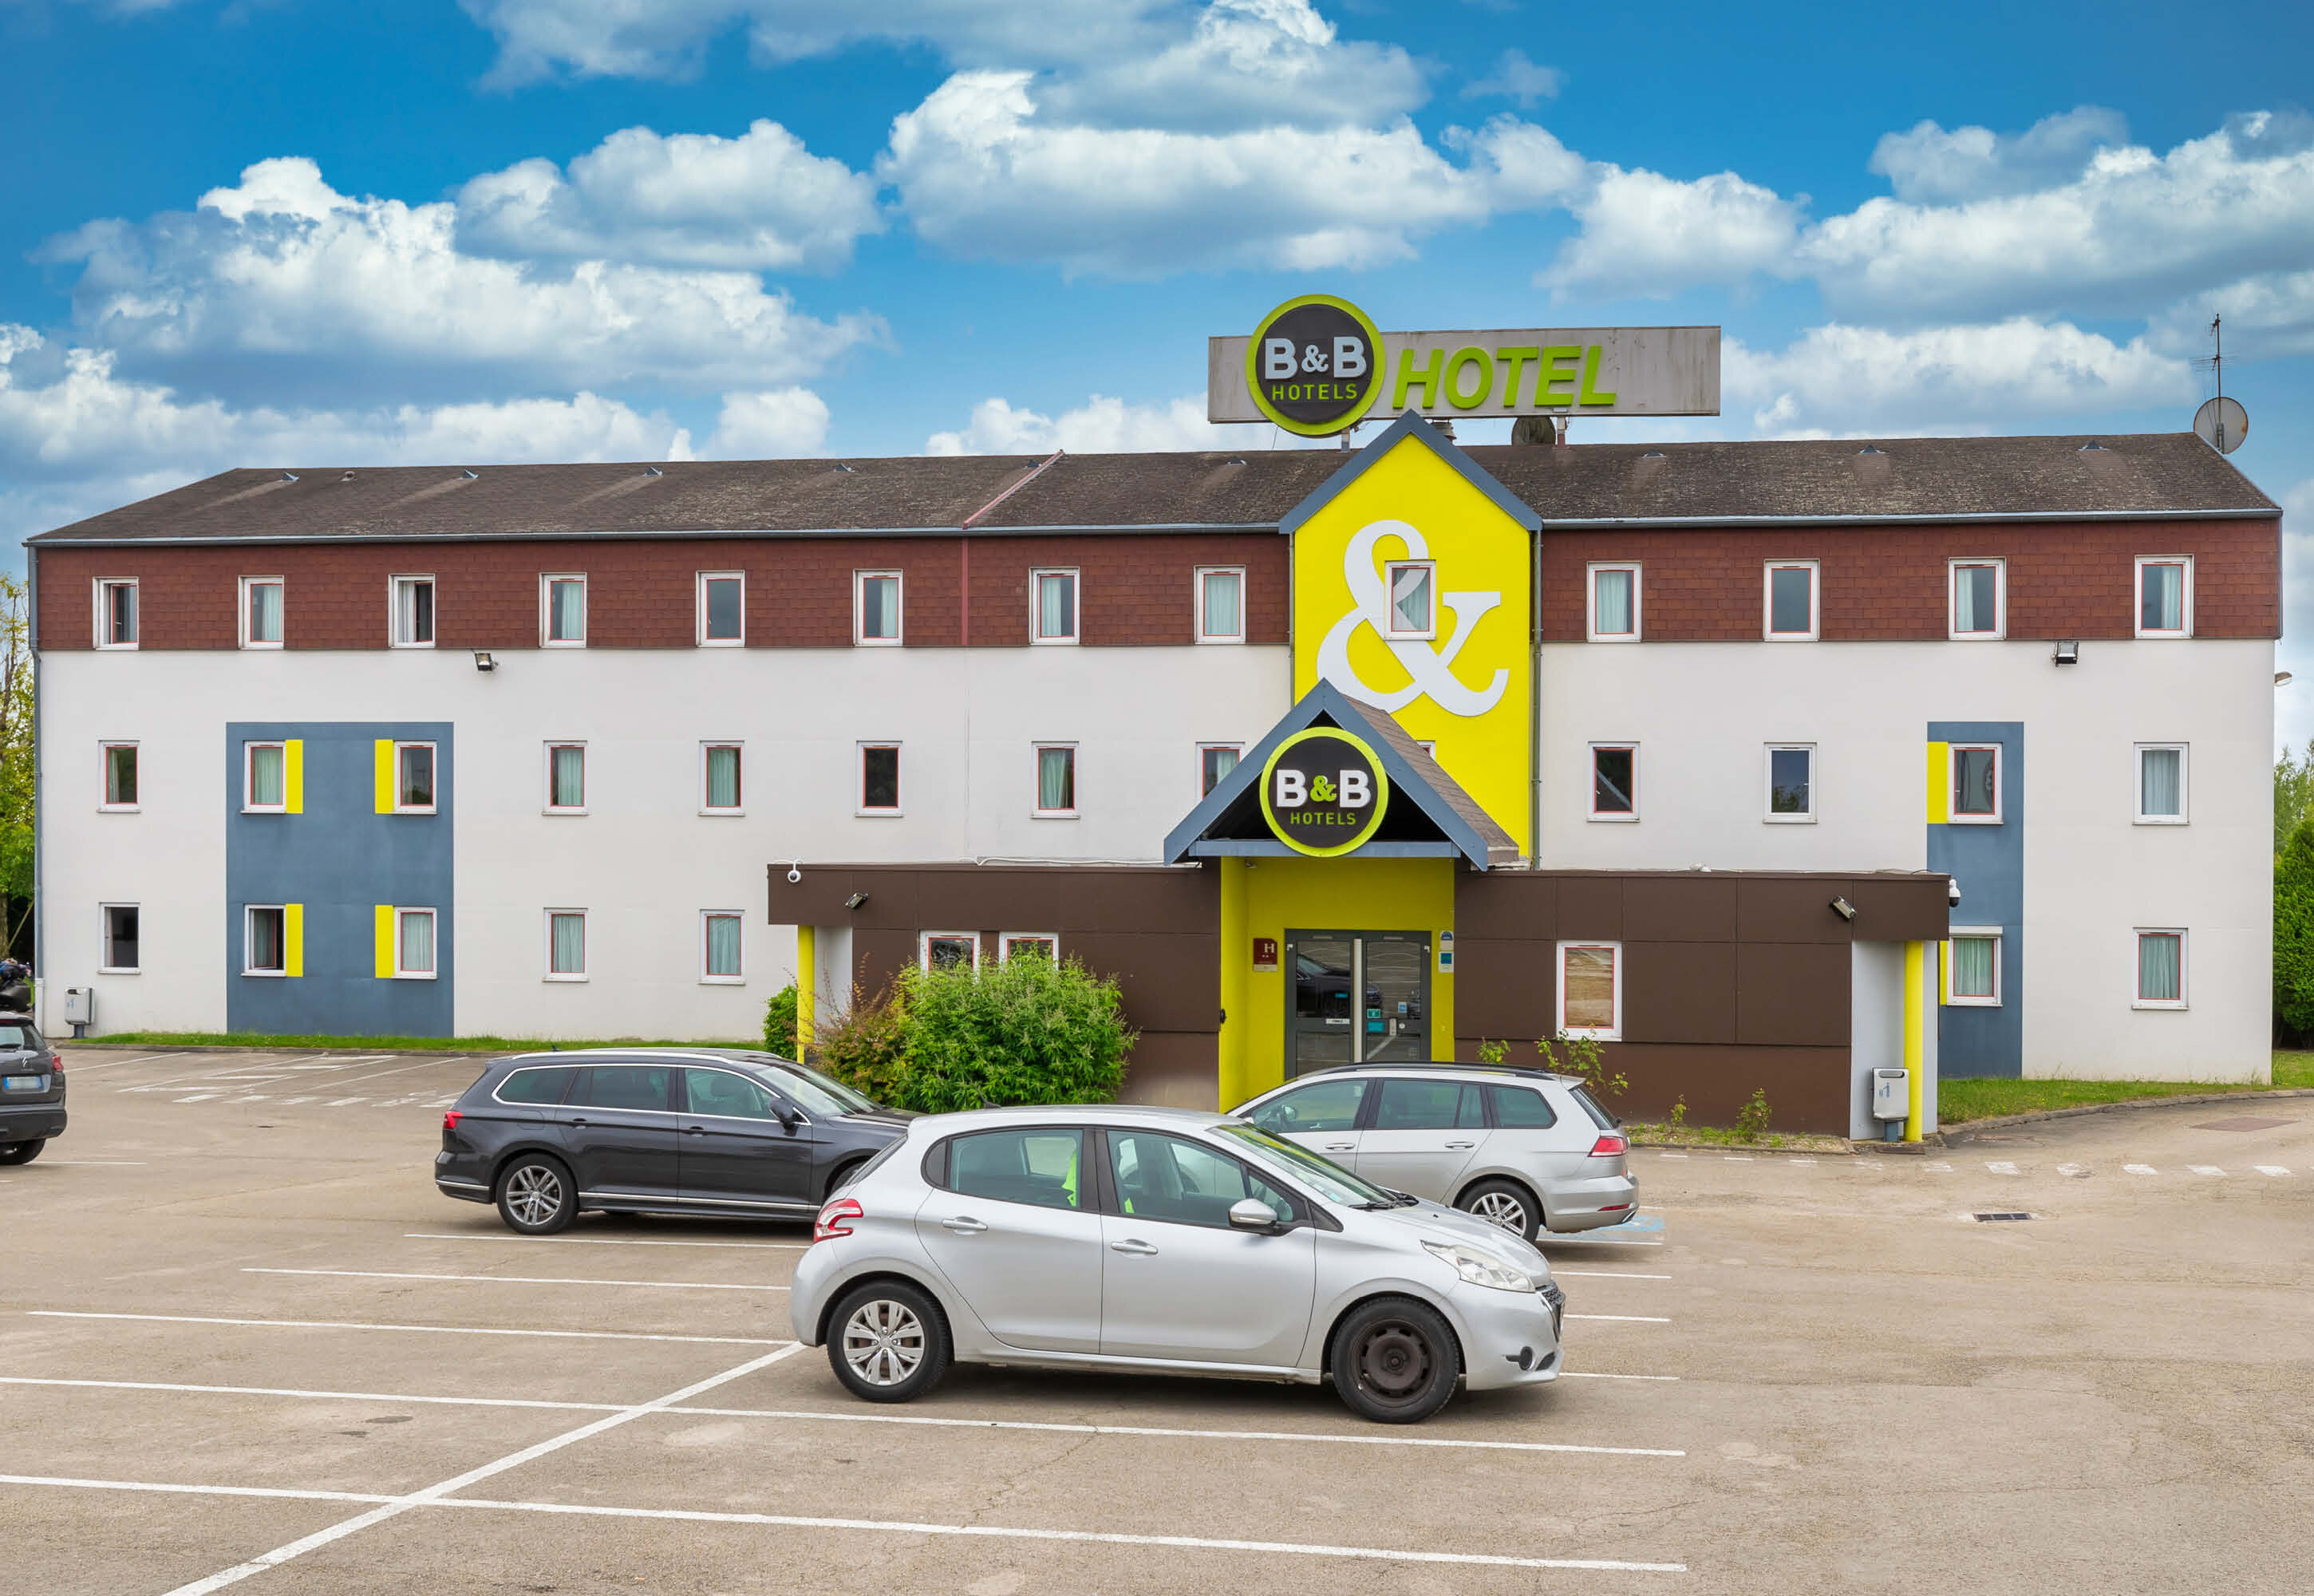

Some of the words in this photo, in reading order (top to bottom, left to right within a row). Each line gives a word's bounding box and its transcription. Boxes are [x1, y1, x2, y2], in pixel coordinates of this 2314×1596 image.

[1265, 336, 1368, 380] B&B
[1392, 346, 1617, 409] HOTEL
[1272, 383, 1358, 401] HOTELS
[1317, 519, 1510, 717] &
[1277, 769, 1372, 808] B&B
[1290, 812, 1356, 825] HOTELS
[1264, 943, 1275, 953] H
